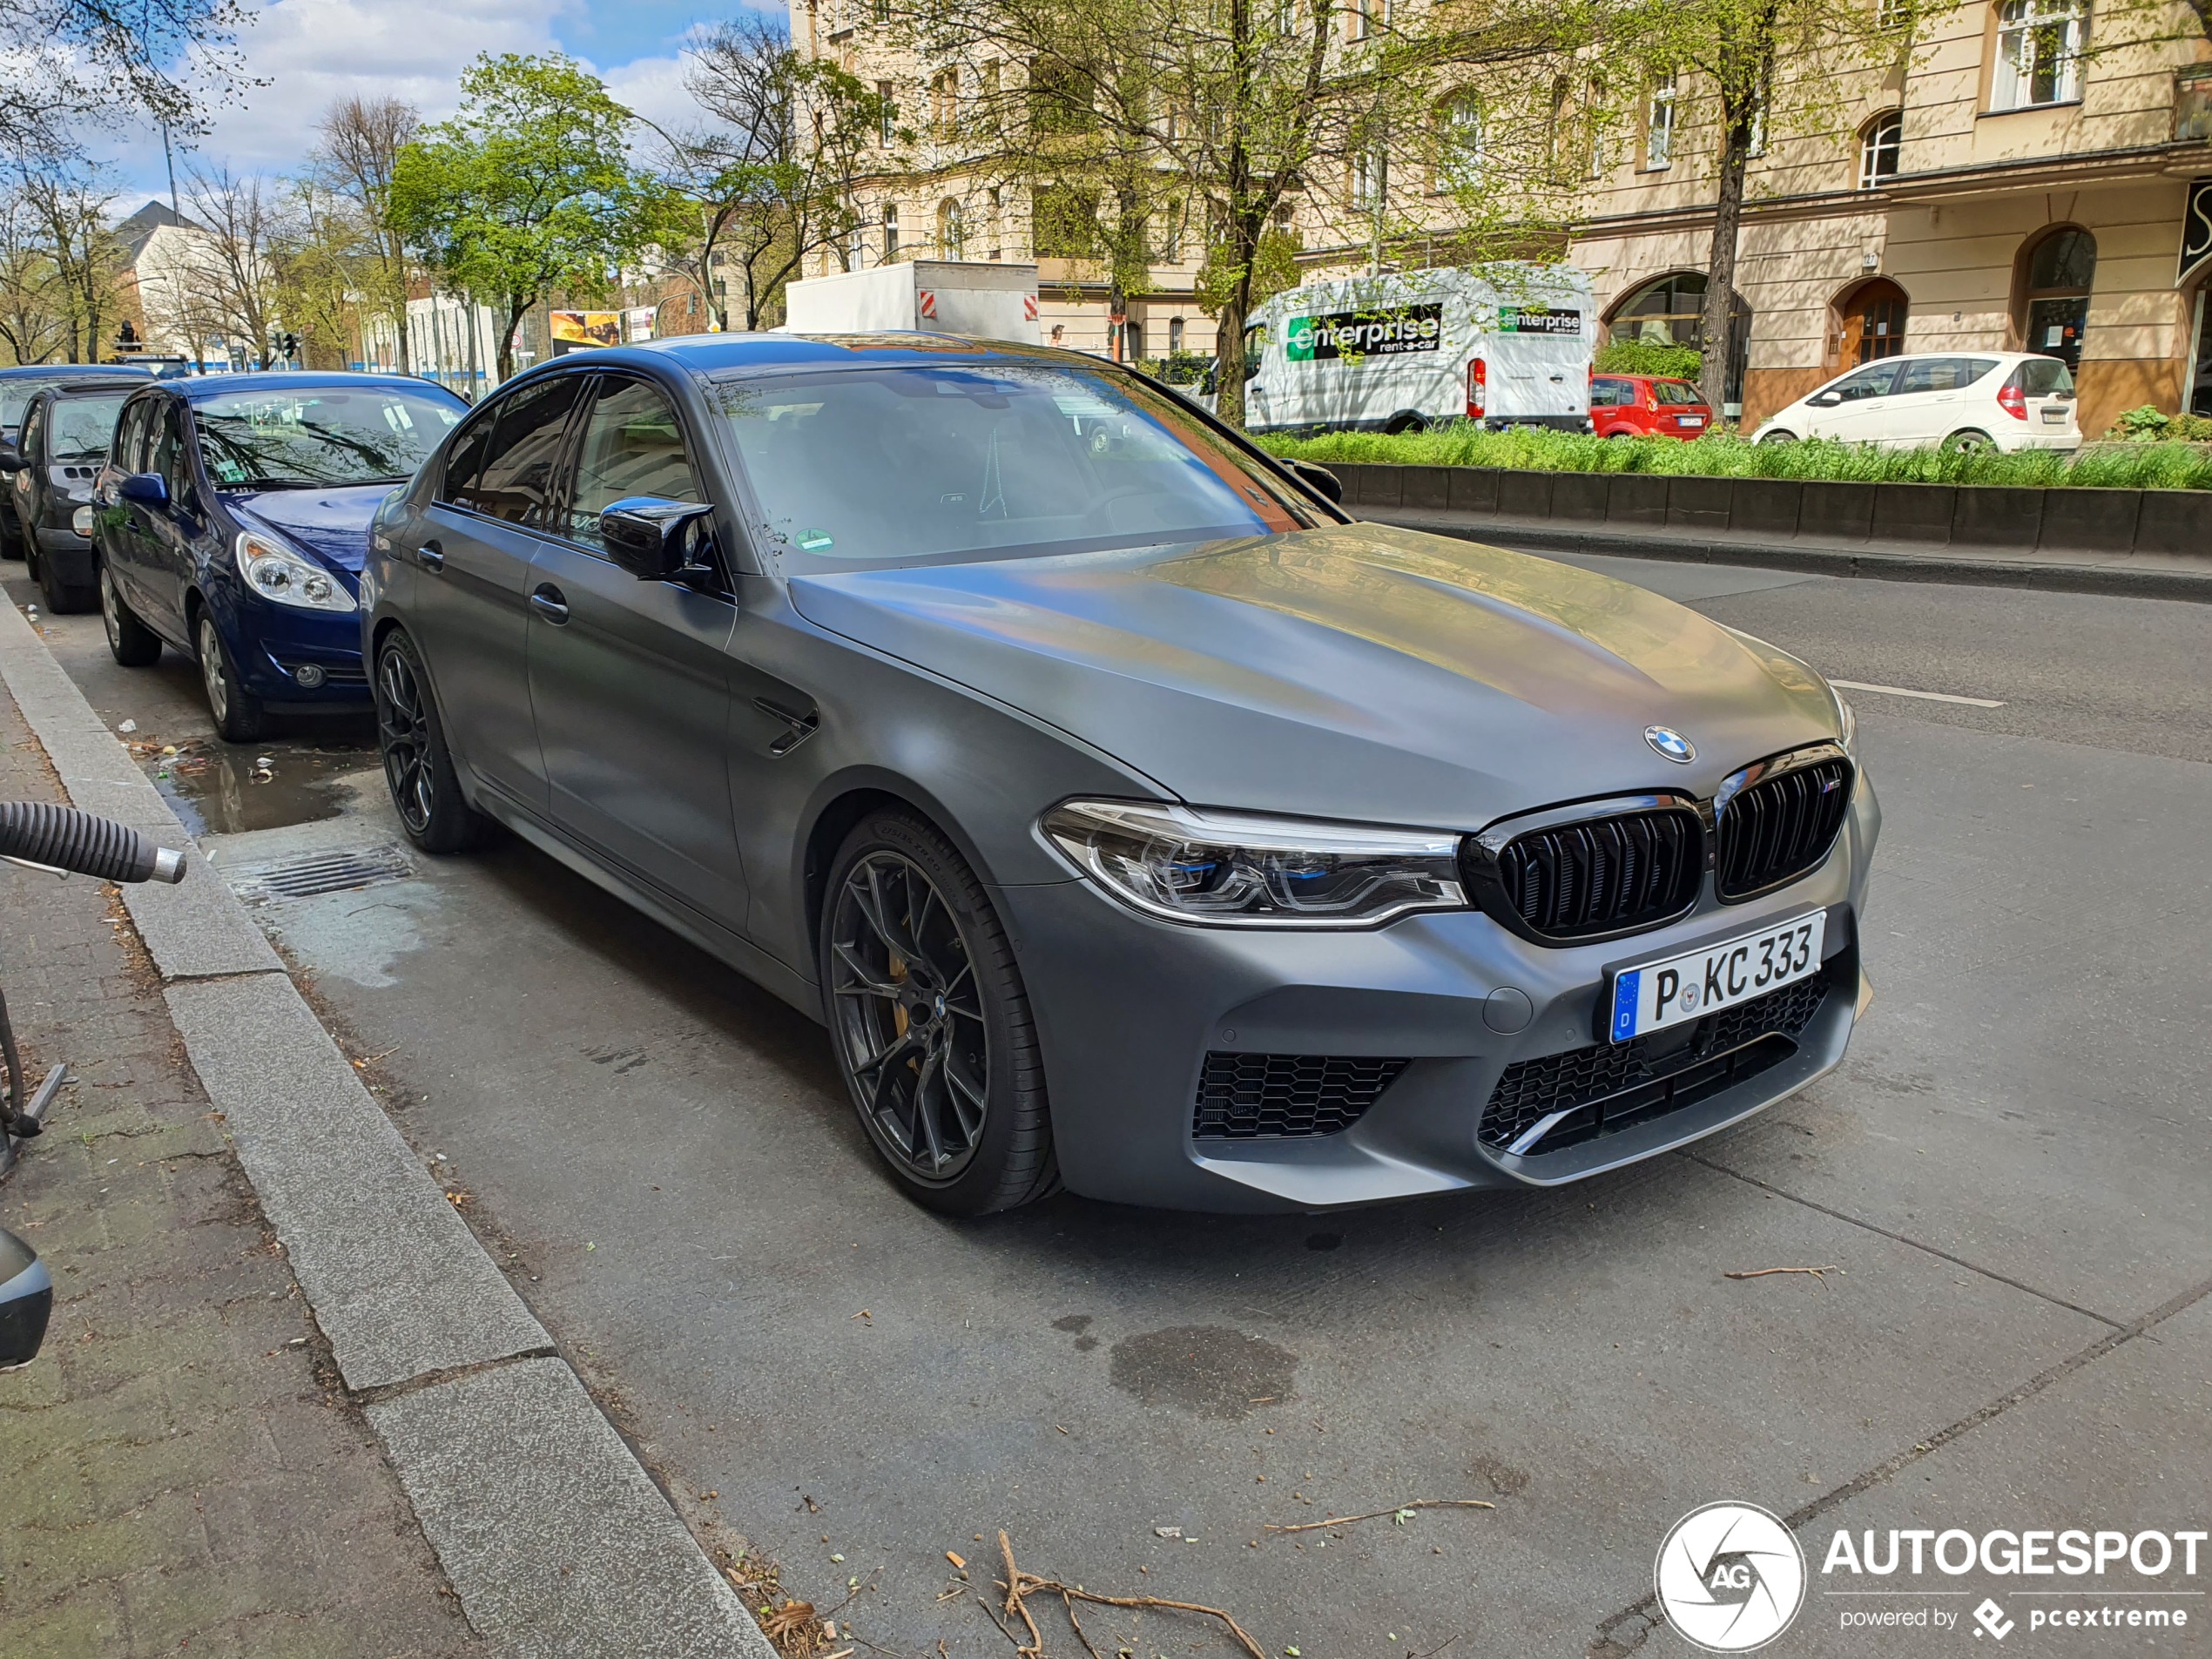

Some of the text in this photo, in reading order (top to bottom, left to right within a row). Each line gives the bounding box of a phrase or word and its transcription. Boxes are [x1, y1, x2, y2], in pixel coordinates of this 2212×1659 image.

[1500, 313, 1580, 331] enterprise
[1289, 318, 1440, 350] enterprise
[1379, 340, 1437, 353] rent-a-car
[1656, 923, 1812, 1021] P KC 333
[1620, 1012, 1630, 1028] D
